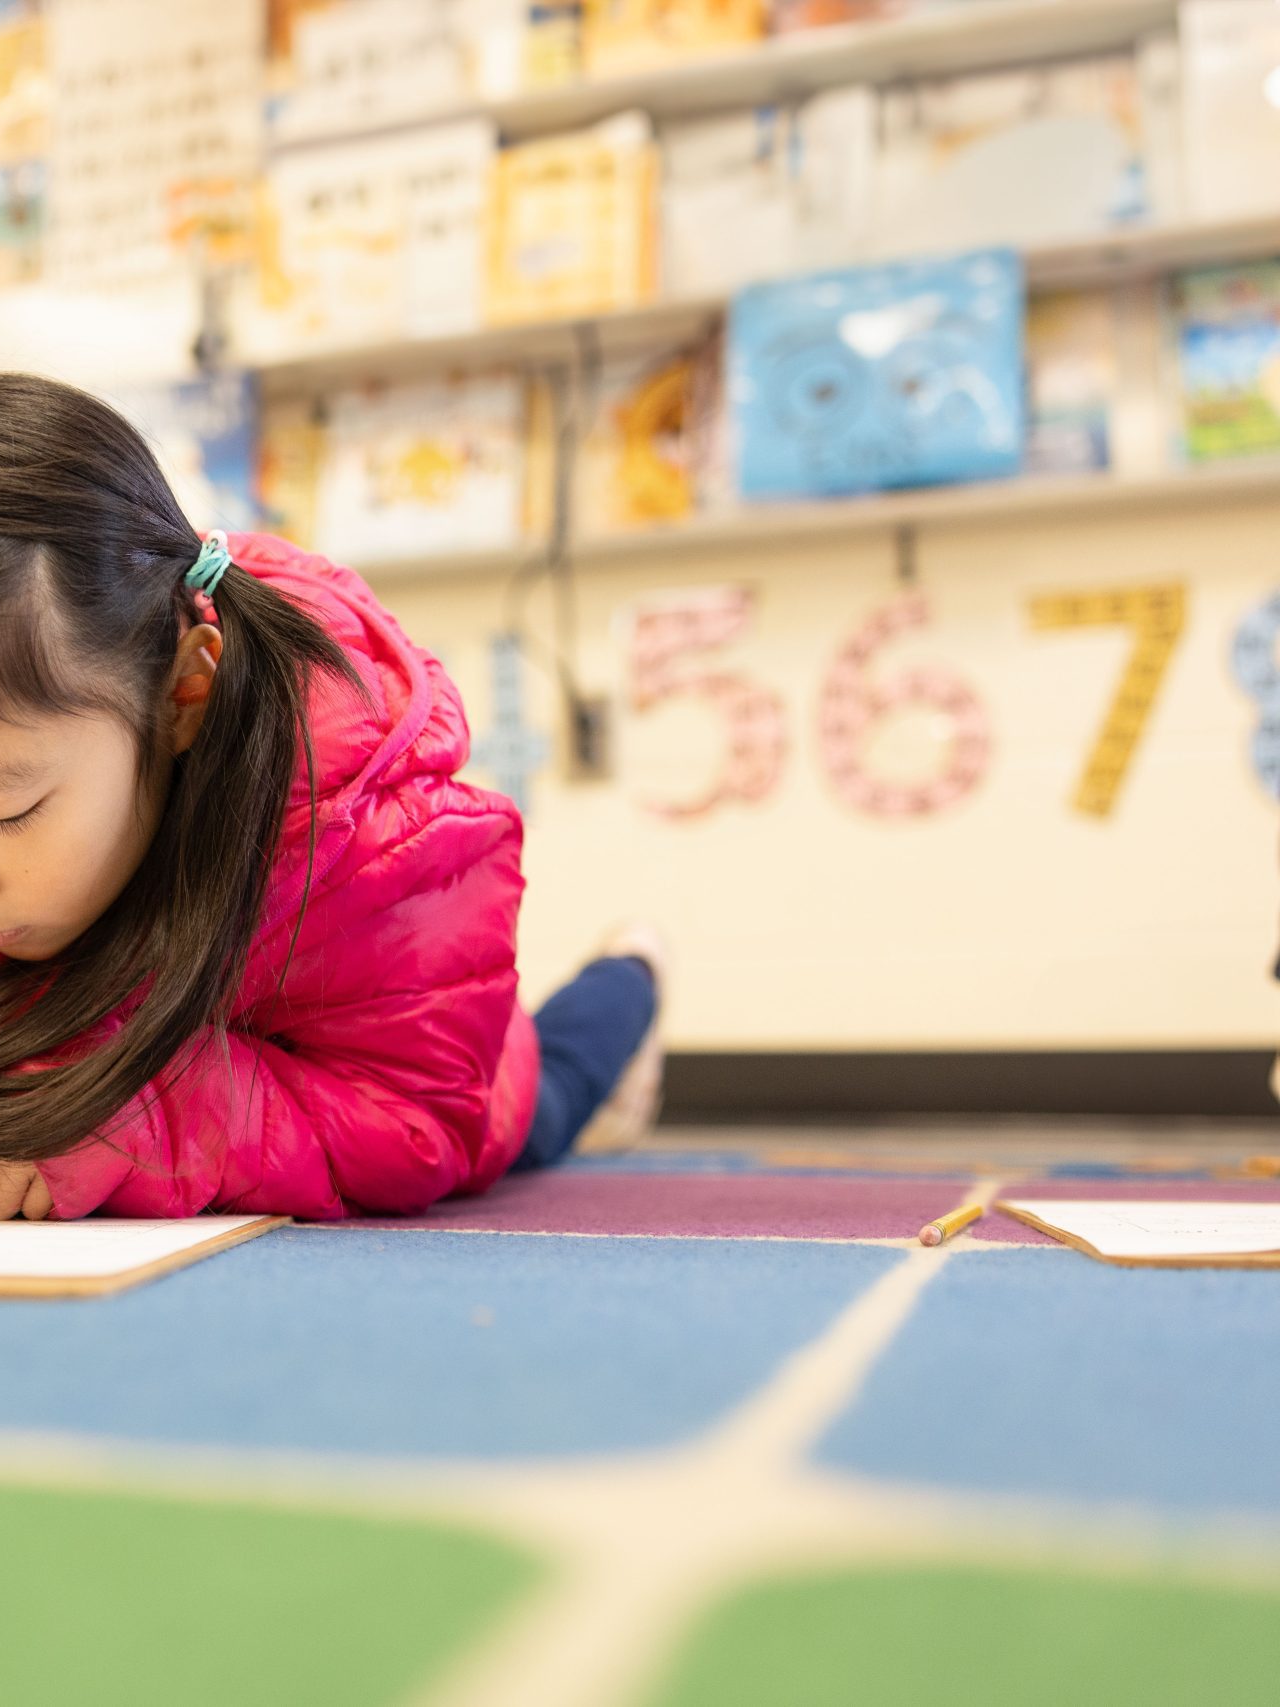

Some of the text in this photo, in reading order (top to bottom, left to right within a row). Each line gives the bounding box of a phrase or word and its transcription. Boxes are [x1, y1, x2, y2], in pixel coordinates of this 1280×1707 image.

[626, 580, 788, 824] 5
[820, 584, 993, 822] 6
[1024, 580, 1188, 818] 7
